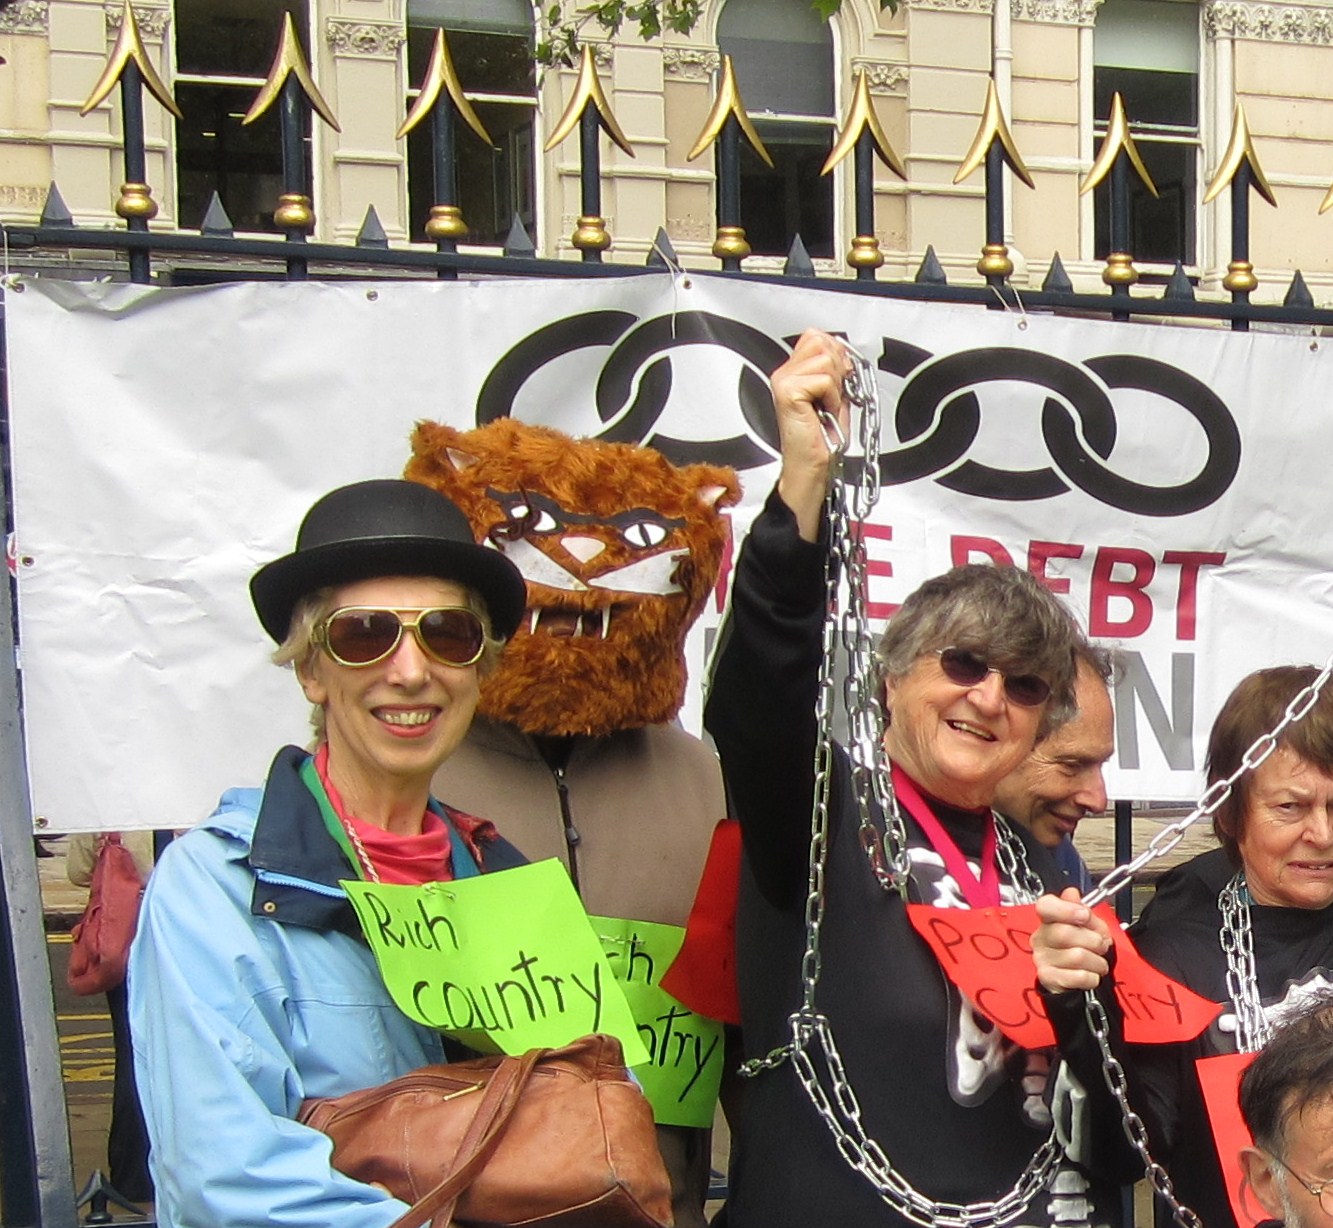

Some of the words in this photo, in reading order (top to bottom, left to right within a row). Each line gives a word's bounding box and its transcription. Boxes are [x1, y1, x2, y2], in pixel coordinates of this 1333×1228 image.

[363, 891, 459, 952] Rich
[412, 950, 602, 1033] country
[637, 1006, 719, 1103] ntry
